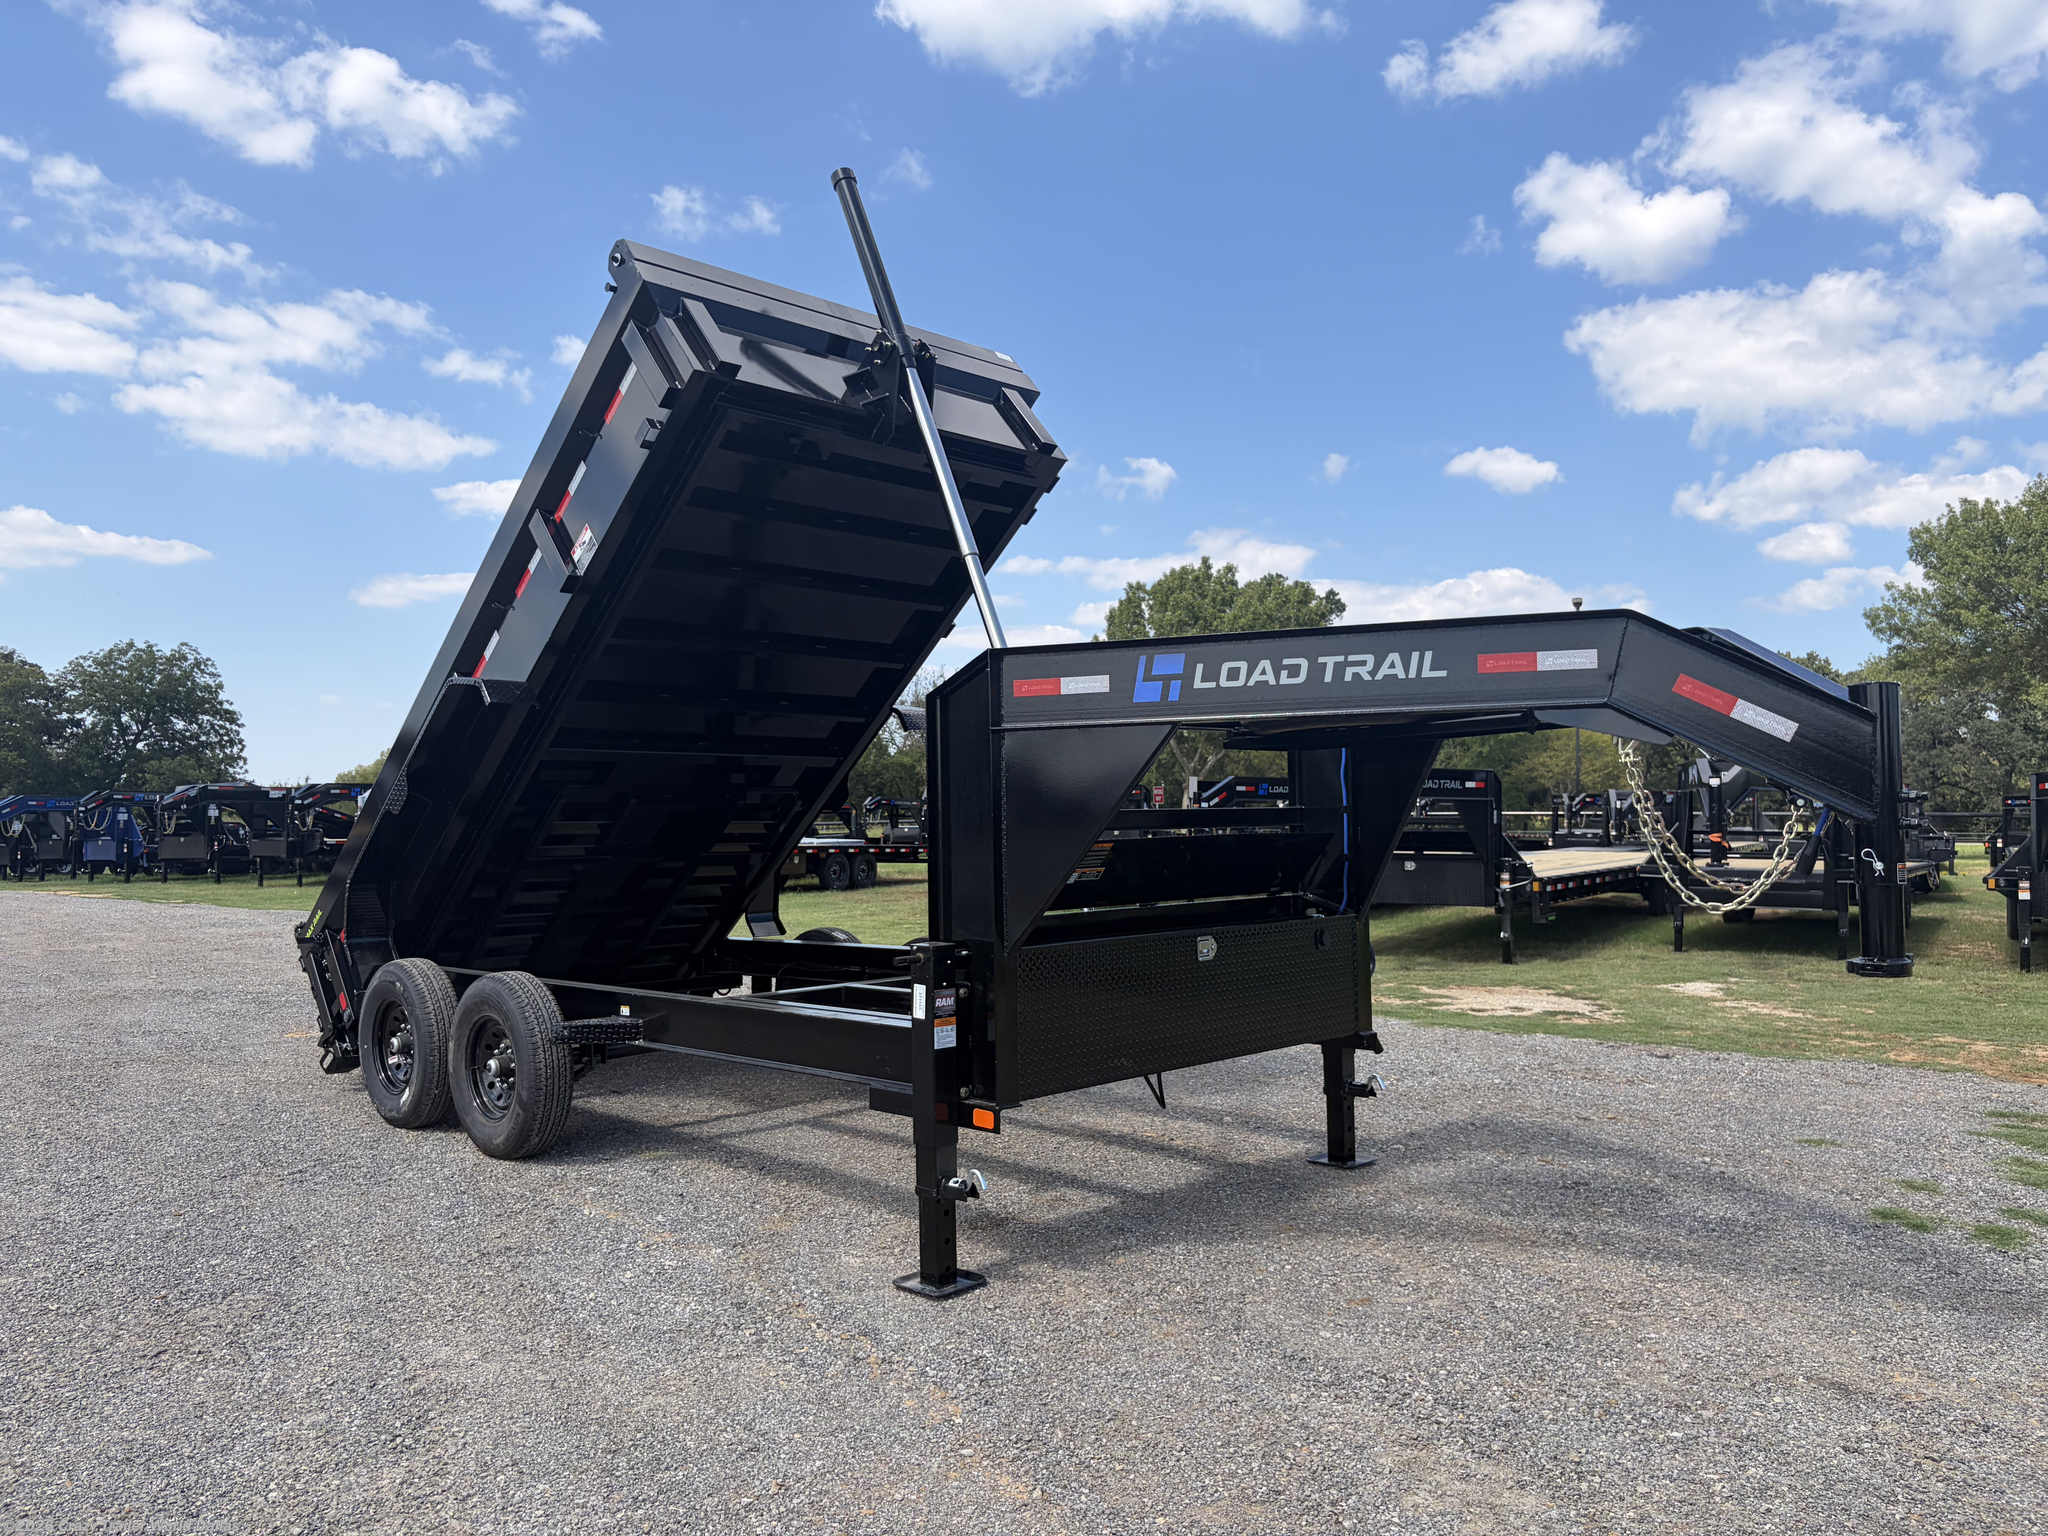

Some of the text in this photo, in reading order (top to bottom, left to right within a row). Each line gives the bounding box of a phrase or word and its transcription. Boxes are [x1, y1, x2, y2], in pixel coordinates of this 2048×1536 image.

[1193, 650, 1448, 689] LOAD TRAIL
[1440, 780, 1463, 789] TRAIL
[936, 997, 955, 1007] RAM
